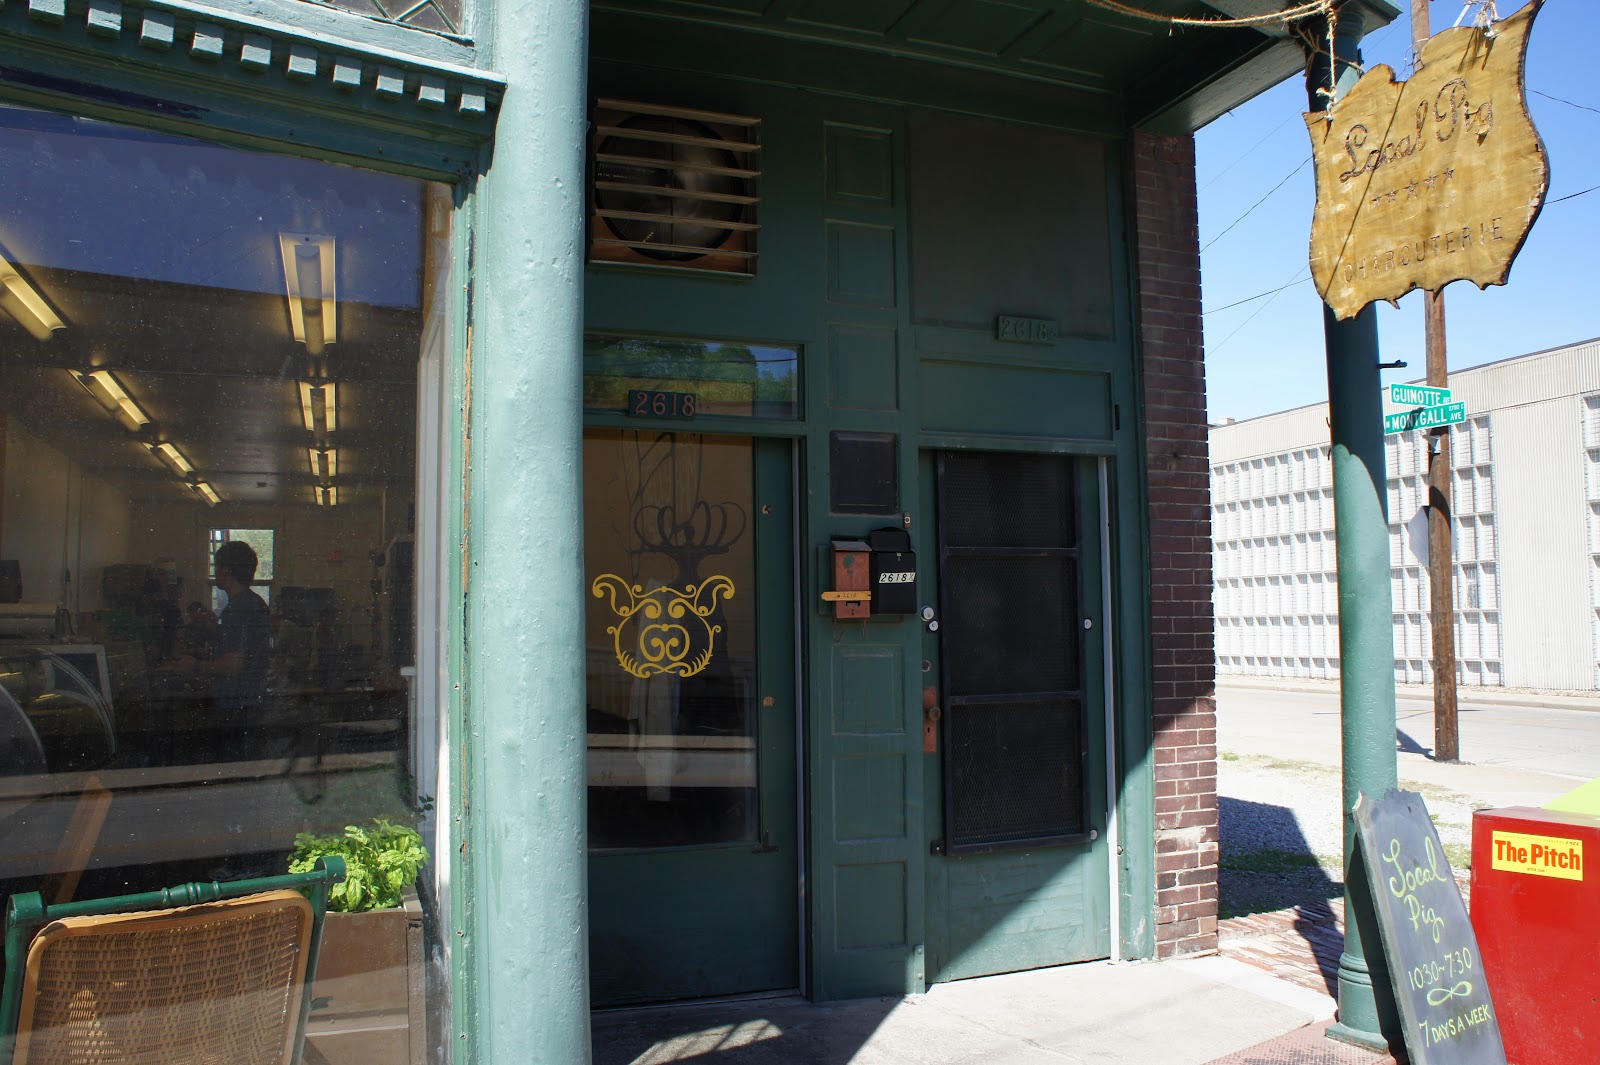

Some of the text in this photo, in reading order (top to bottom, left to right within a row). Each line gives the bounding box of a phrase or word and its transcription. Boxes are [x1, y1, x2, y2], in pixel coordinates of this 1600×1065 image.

[1339, 77, 1494, 183] Local Pig
[1342, 217, 1504, 285] CHARCUTERIE
[635, 392, 695, 417] 2618
[1392, 387, 1442, 406] GUINOTTE
[1391, 408, 1447, 431] MONTGALL
[1450, 411, 1462, 421] AVE
[1382, 835, 1446, 898] Local
[1494, 839, 1581, 871] The Pitch
[1403, 894, 1445, 944] Pig
[1418, 1004, 1492, 1048] 7 DAYS A WEEK
